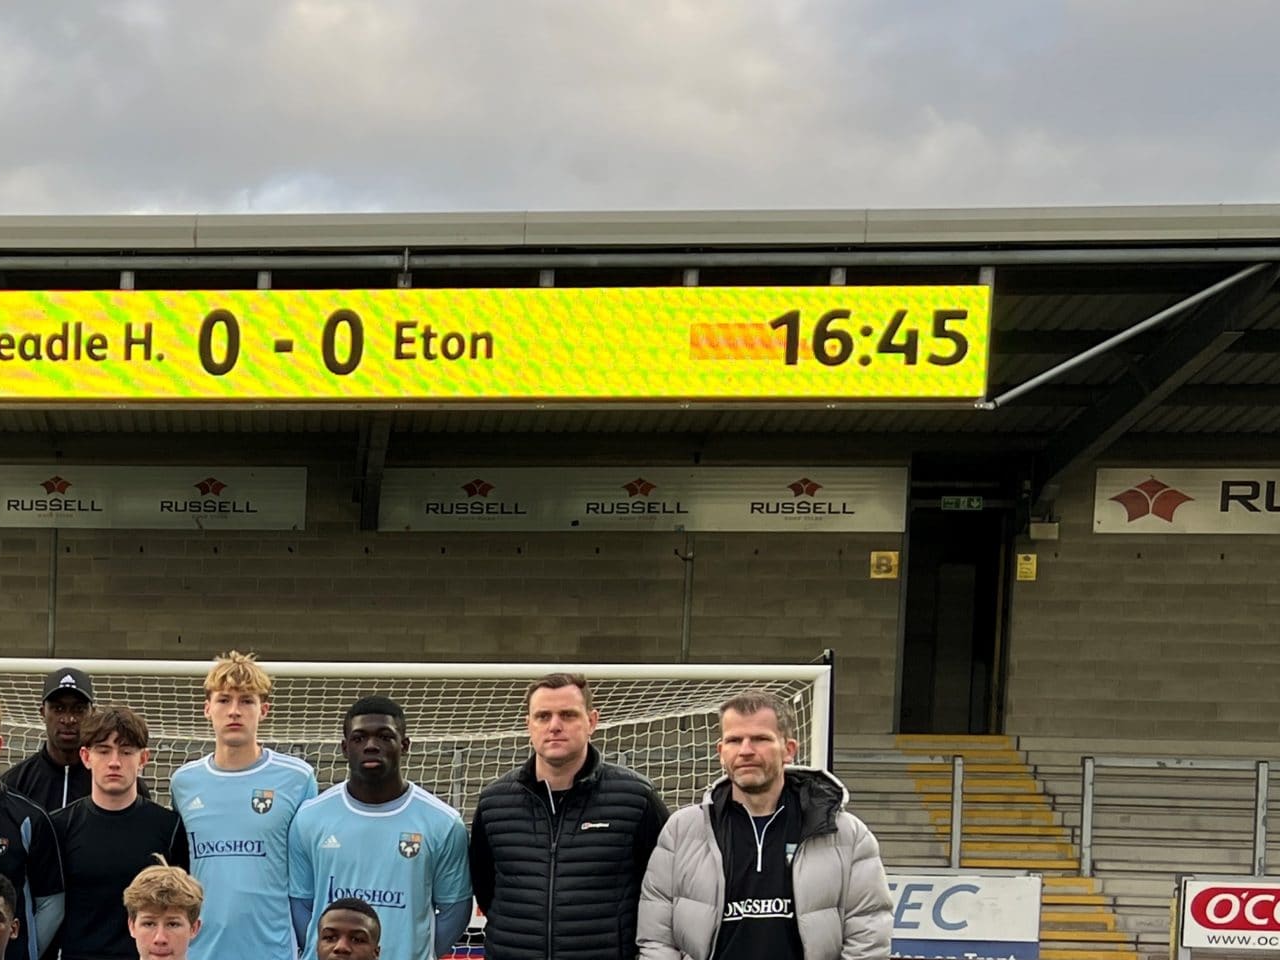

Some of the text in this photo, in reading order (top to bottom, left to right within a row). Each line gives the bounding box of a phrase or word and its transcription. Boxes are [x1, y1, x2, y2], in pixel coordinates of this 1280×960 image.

[124, 322, 165, 362] H.
[197, 307, 241, 377] 0
[321, 307, 364, 377] 0
[393, 320, 494, 361] Eton
[769, 308, 969, 367] 16:45
[7, 497, 103, 512] RUSSELL
[160, 499, 258, 513] RUSSELL
[425, 500, 527, 515] RUSSELL
[586, 500, 689, 515] RUSSELL
[750, 501, 855, 515] RUSSELL
[190, 832, 267, 859] LONGSHOT
[327, 875, 406, 909] LONGSHOT
[888, 883, 981, 931] EC
[1205, 891, 1280, 926] O'C
